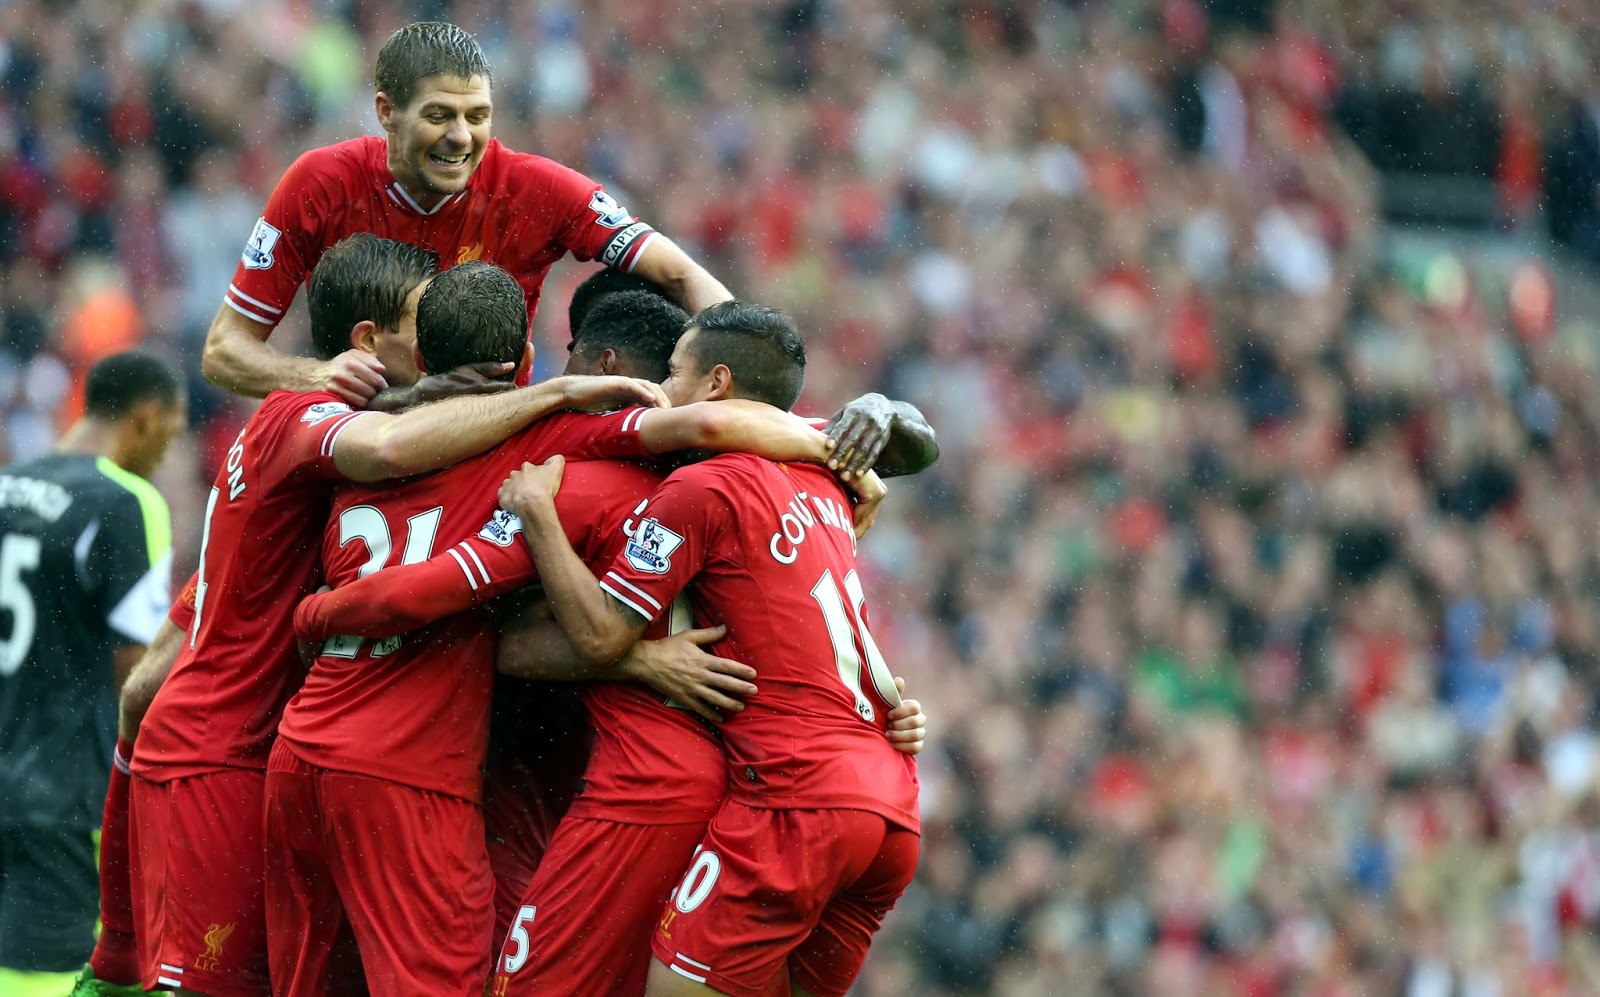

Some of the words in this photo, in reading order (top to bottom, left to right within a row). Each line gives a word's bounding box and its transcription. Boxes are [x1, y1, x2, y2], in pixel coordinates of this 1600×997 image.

[605, 225, 644, 261] CAPTA
[769, 491, 858, 565] COUNHO
[321, 504, 444, 659] 21
[669, 844, 721, 913] 0
[495, 904, 537, 973] 5
